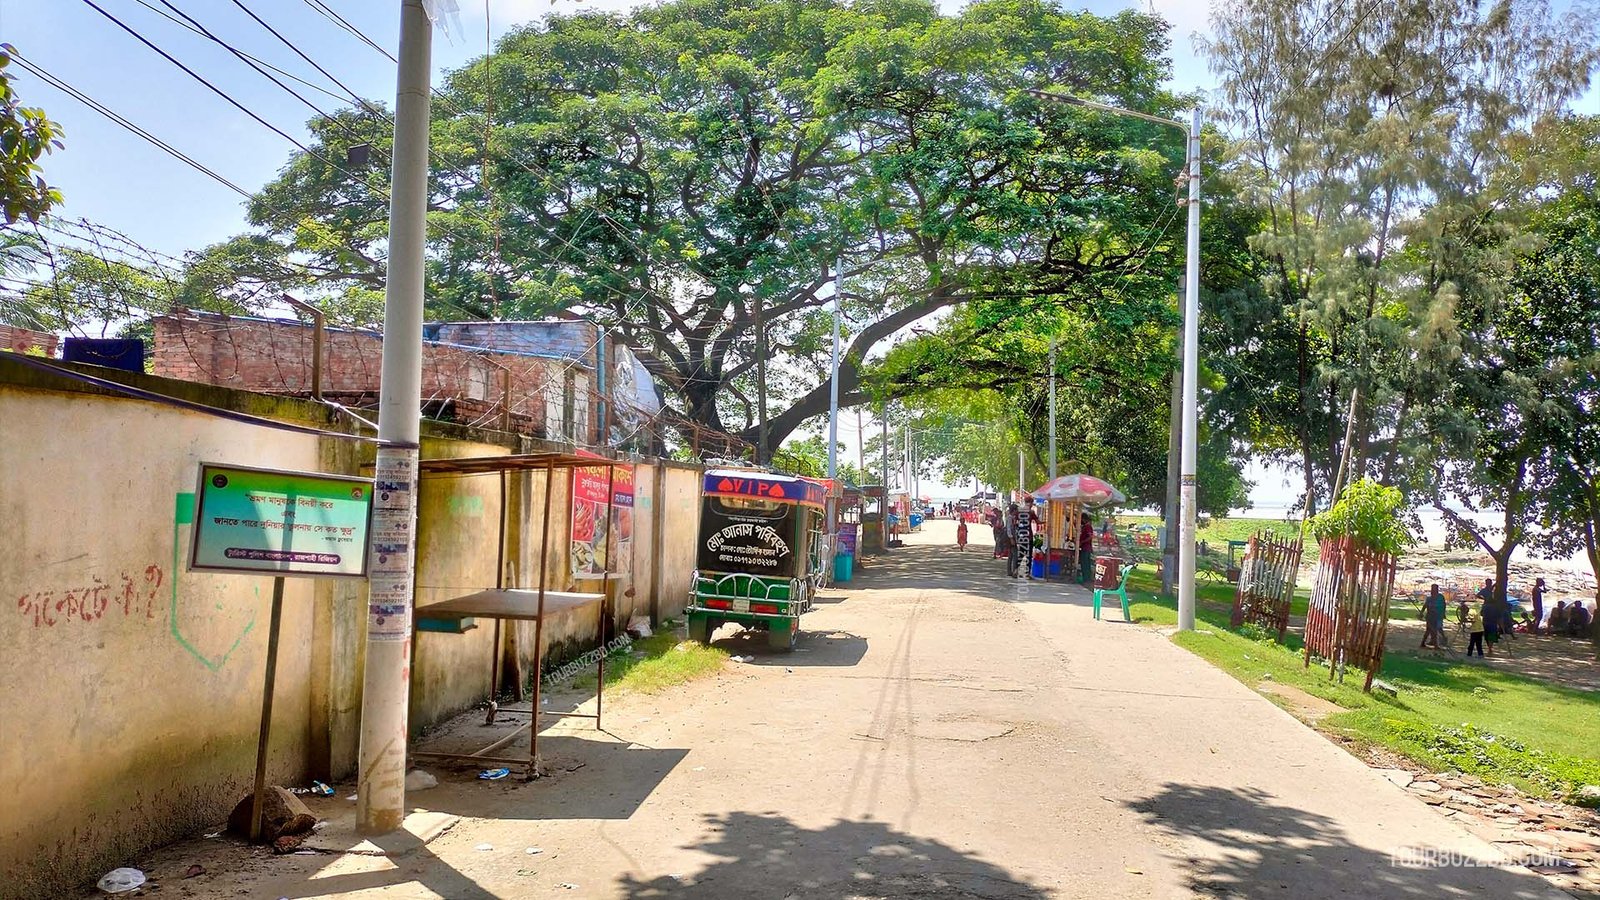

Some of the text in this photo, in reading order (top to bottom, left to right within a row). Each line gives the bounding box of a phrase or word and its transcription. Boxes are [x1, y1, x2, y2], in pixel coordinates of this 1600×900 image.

[733, 479, 769, 496] VIP
[213, 517, 238, 527] জানতে
[241, 520, 258, 528] পারে
[721, 523, 754, 539] আনাস
